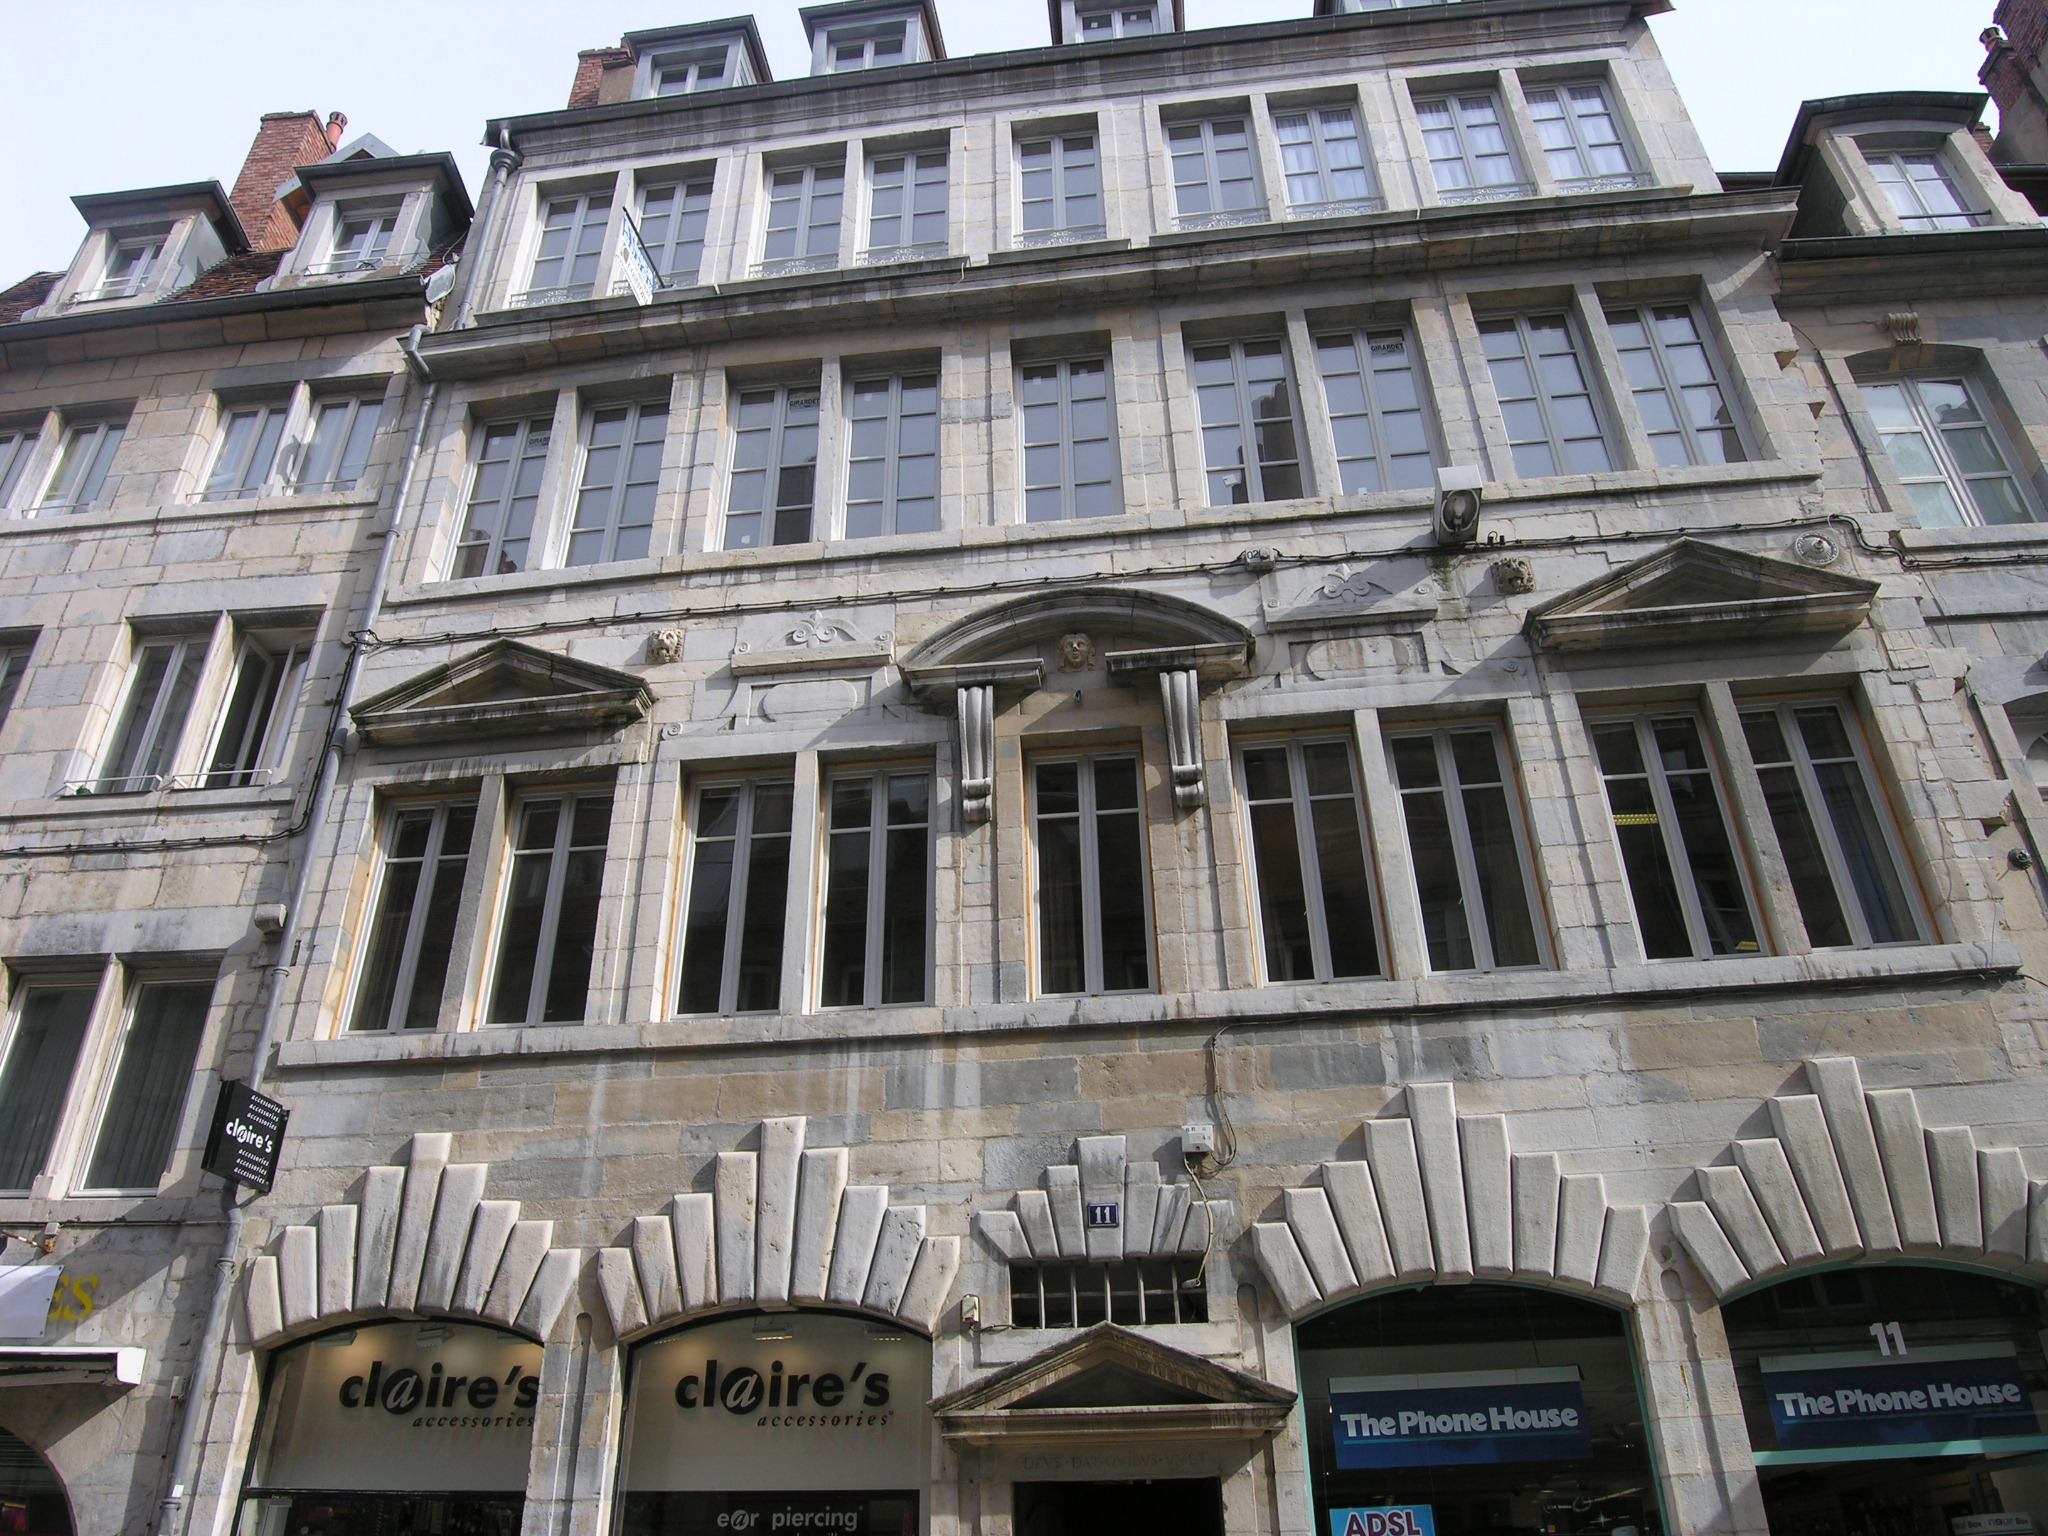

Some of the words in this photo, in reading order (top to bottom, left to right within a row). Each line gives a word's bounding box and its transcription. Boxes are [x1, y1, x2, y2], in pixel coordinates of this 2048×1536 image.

[1370, 343, 1404, 351] GIRARDET
[249, 1103, 279, 1122] accessories
[251, 1094, 281, 1114] accessories
[247, 1112, 277, 1131] accessories
[226, 1118, 273, 1153] claire's
[236, 1158, 267, 1176] accessories
[238, 1149, 270, 1167] accessories
[1095, 1206, 1111, 1223] 11
[1869, 1321, 1908, 1356] 11
[339, 1361, 541, 1415] claire's
[675, 1359, 890, 1415] claire's
[1775, 1392, 1835, 1417] The
[1835, 1388, 1928, 1414] Phone
[1926, 1383, 2021, 1408] House
[412, 1411, 535, 1428] accessories
[1340, 1413, 1396, 1437] The
[1398, 1410, 1488, 1435] Phone
[1488, 1406, 1579, 1431] House
[716, 1509, 760, 1530] ear
[772, 1505, 858, 1532] piercing
[1344, 1509, 1422, 1536] ADSL
